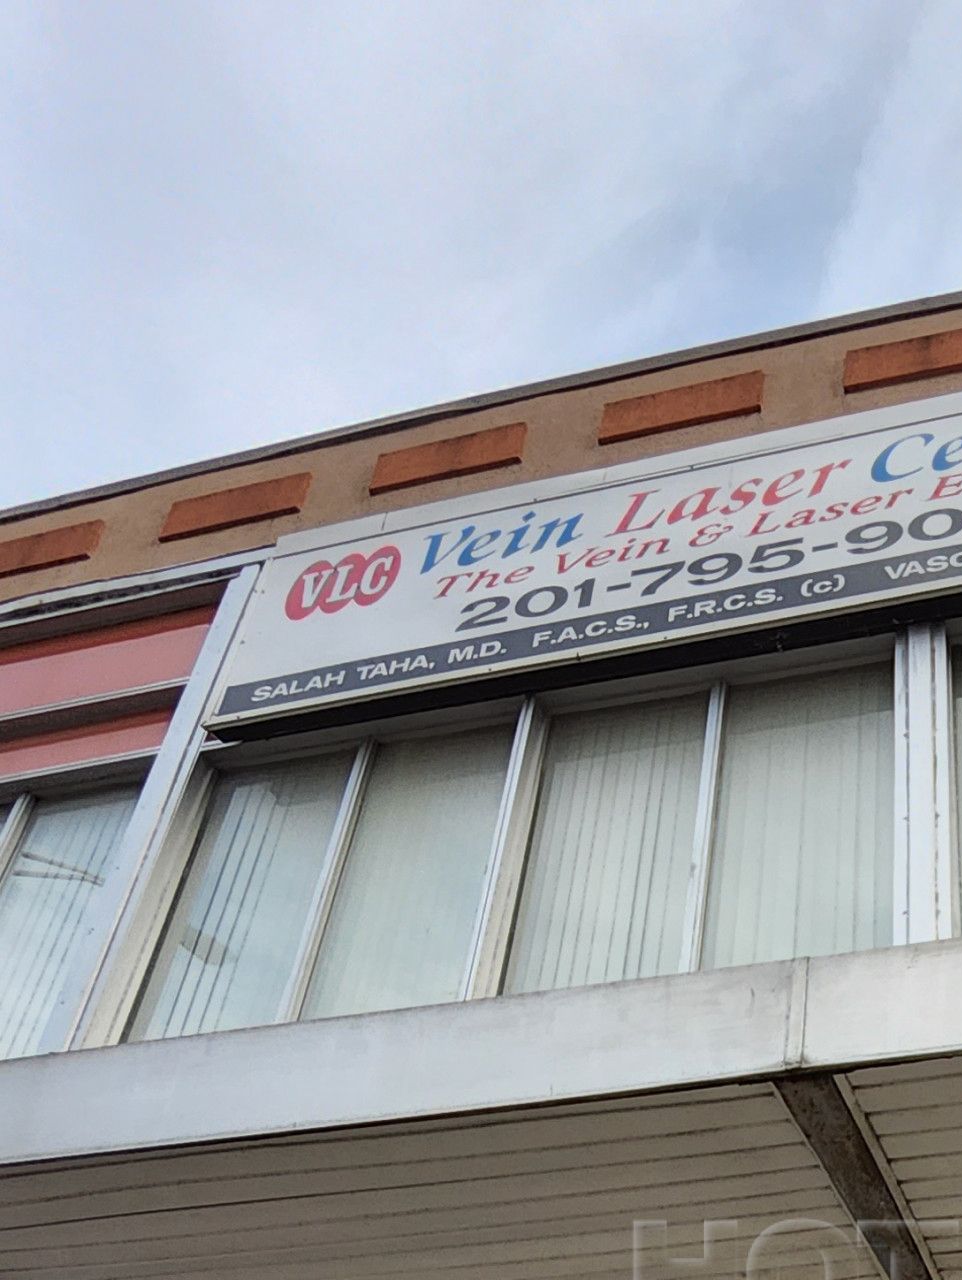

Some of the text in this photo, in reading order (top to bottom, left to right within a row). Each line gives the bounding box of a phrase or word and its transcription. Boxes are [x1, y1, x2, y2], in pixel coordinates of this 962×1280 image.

[419, 510, 586, 575] Vein
[603, 458, 853, 539] Laser
[432, 561, 535, 601] The
[554, 536, 671, 574] Vein
[688, 523, 735, 548] &
[745, 485, 916, 538] Laser
[301, 555, 395, 610] VLC
[250, 669, 345, 702] SALAH
[355, 654, 436, 681] TAHA,
[447, 638, 508, 664] M.D.
[531, 612, 651, 648] F.A.C.S.,
[667, 587, 784, 623] F.R.C.S.
